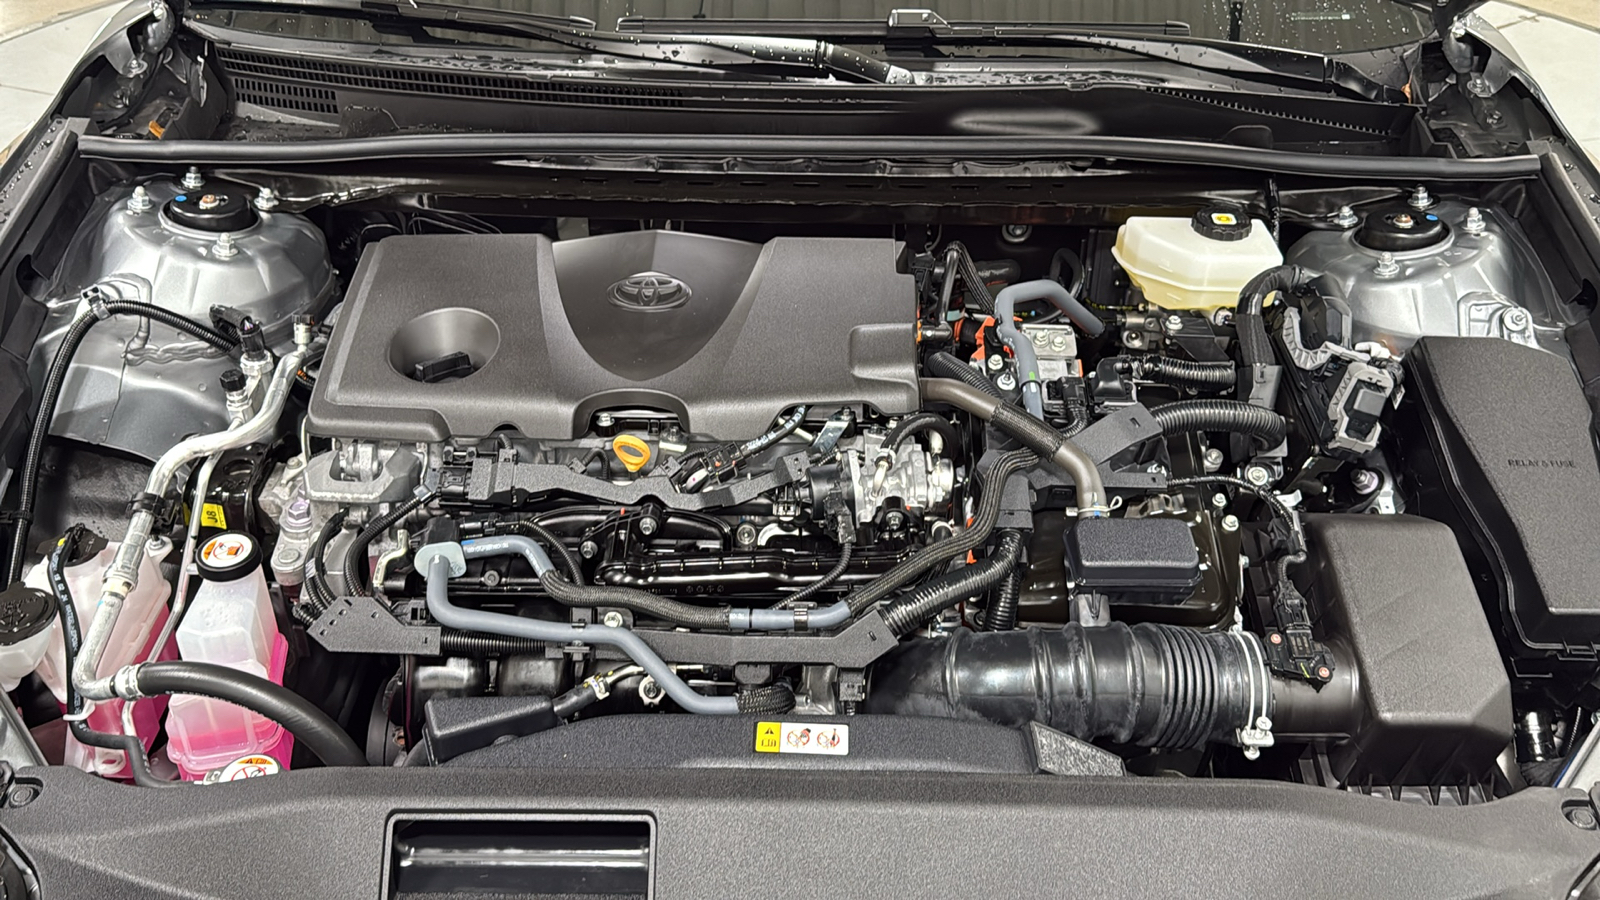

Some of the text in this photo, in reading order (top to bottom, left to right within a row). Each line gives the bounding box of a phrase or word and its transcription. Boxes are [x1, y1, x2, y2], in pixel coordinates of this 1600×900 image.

[1507, 459, 1539, 468] RELAY
[1550, 460, 1576, 468] FUSE
[206, 511, 218, 523] J8
